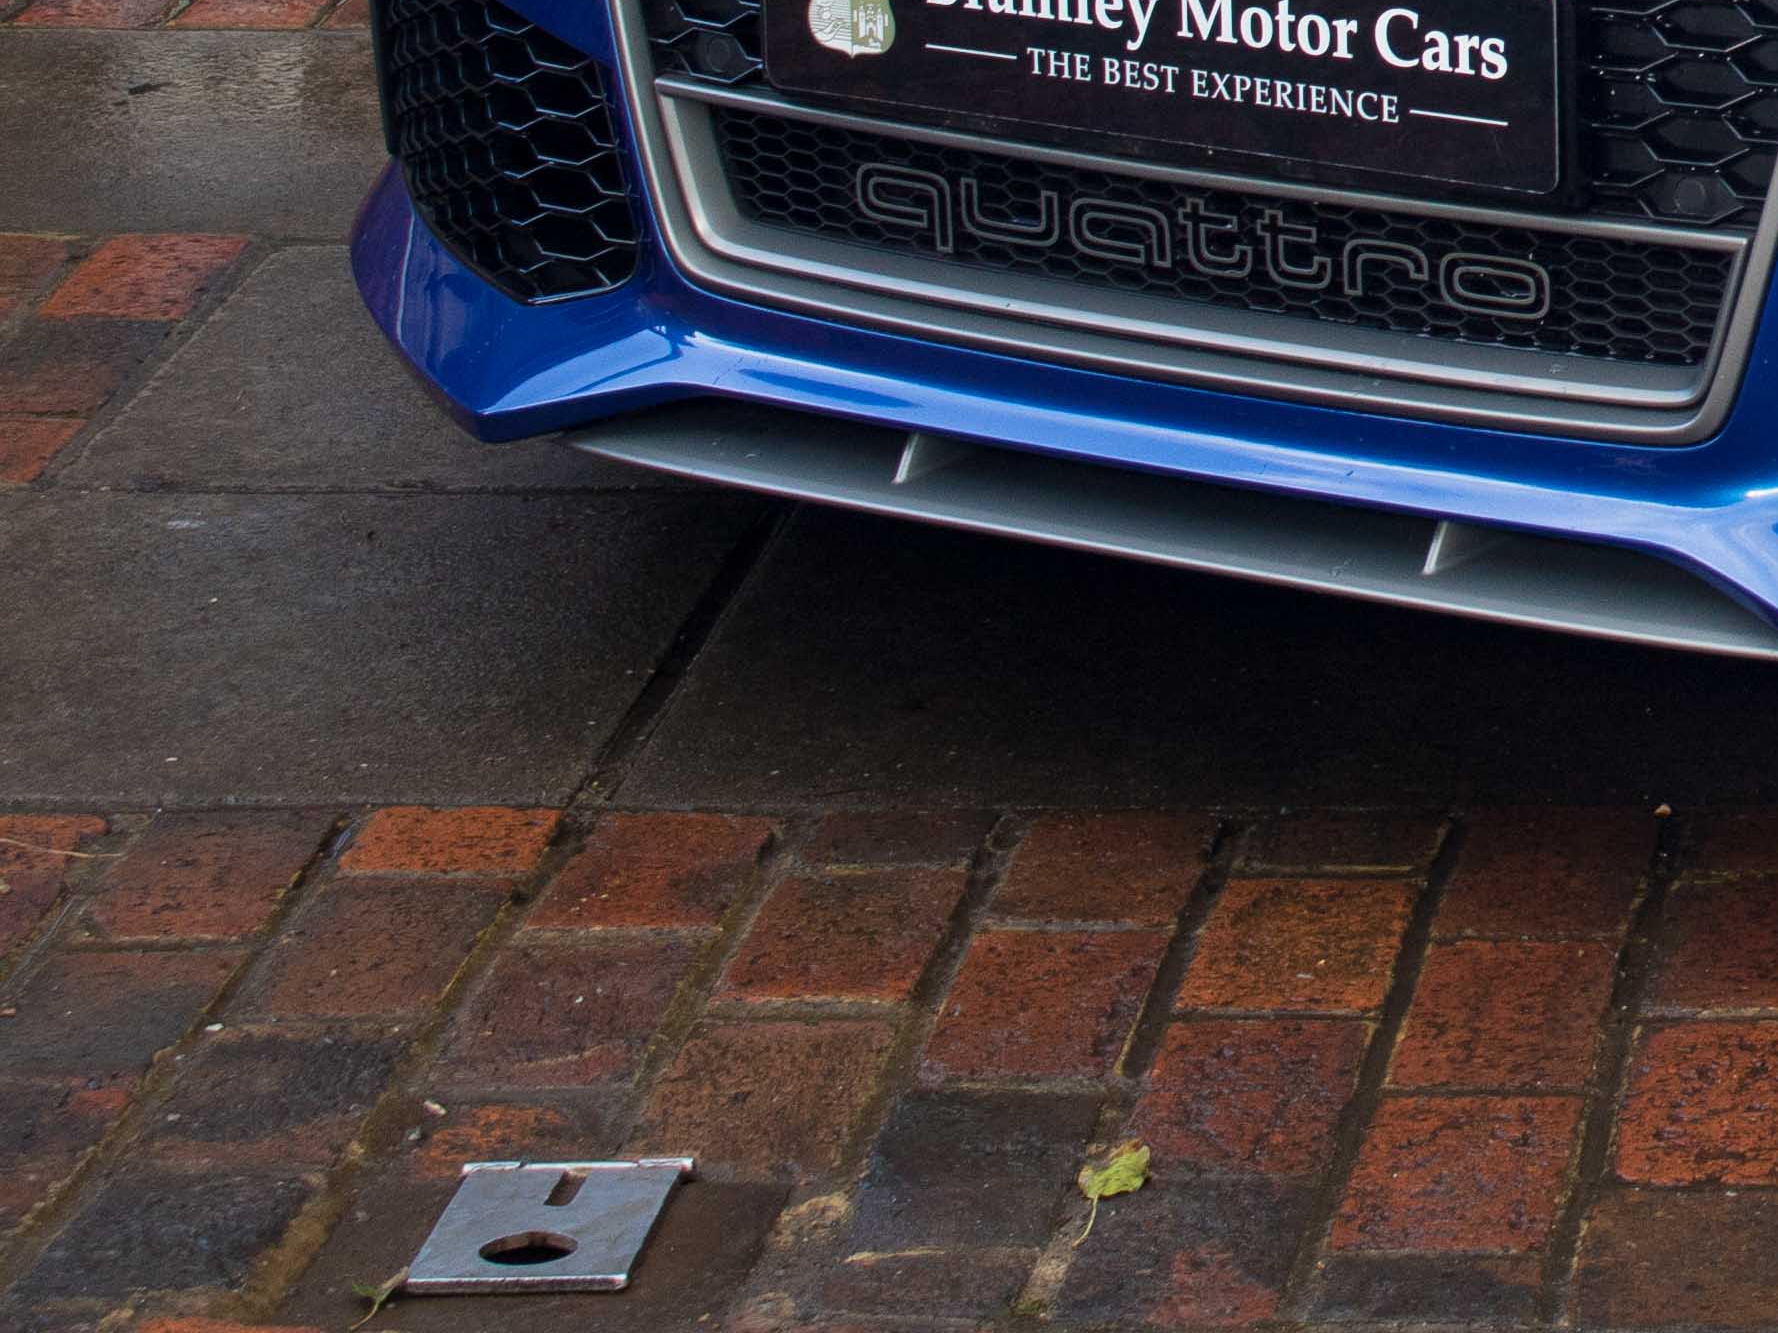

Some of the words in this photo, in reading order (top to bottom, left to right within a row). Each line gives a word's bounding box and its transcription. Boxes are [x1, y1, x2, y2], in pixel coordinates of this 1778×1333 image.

[1374, 7, 1508, 80] Cars
[1026, 46, 1092, 82] THE
[1102, 57, 1180, 93] BEST
[1191, 69, 1401, 124] EXPERIENCE
[855, 161, 1551, 321] quattro
